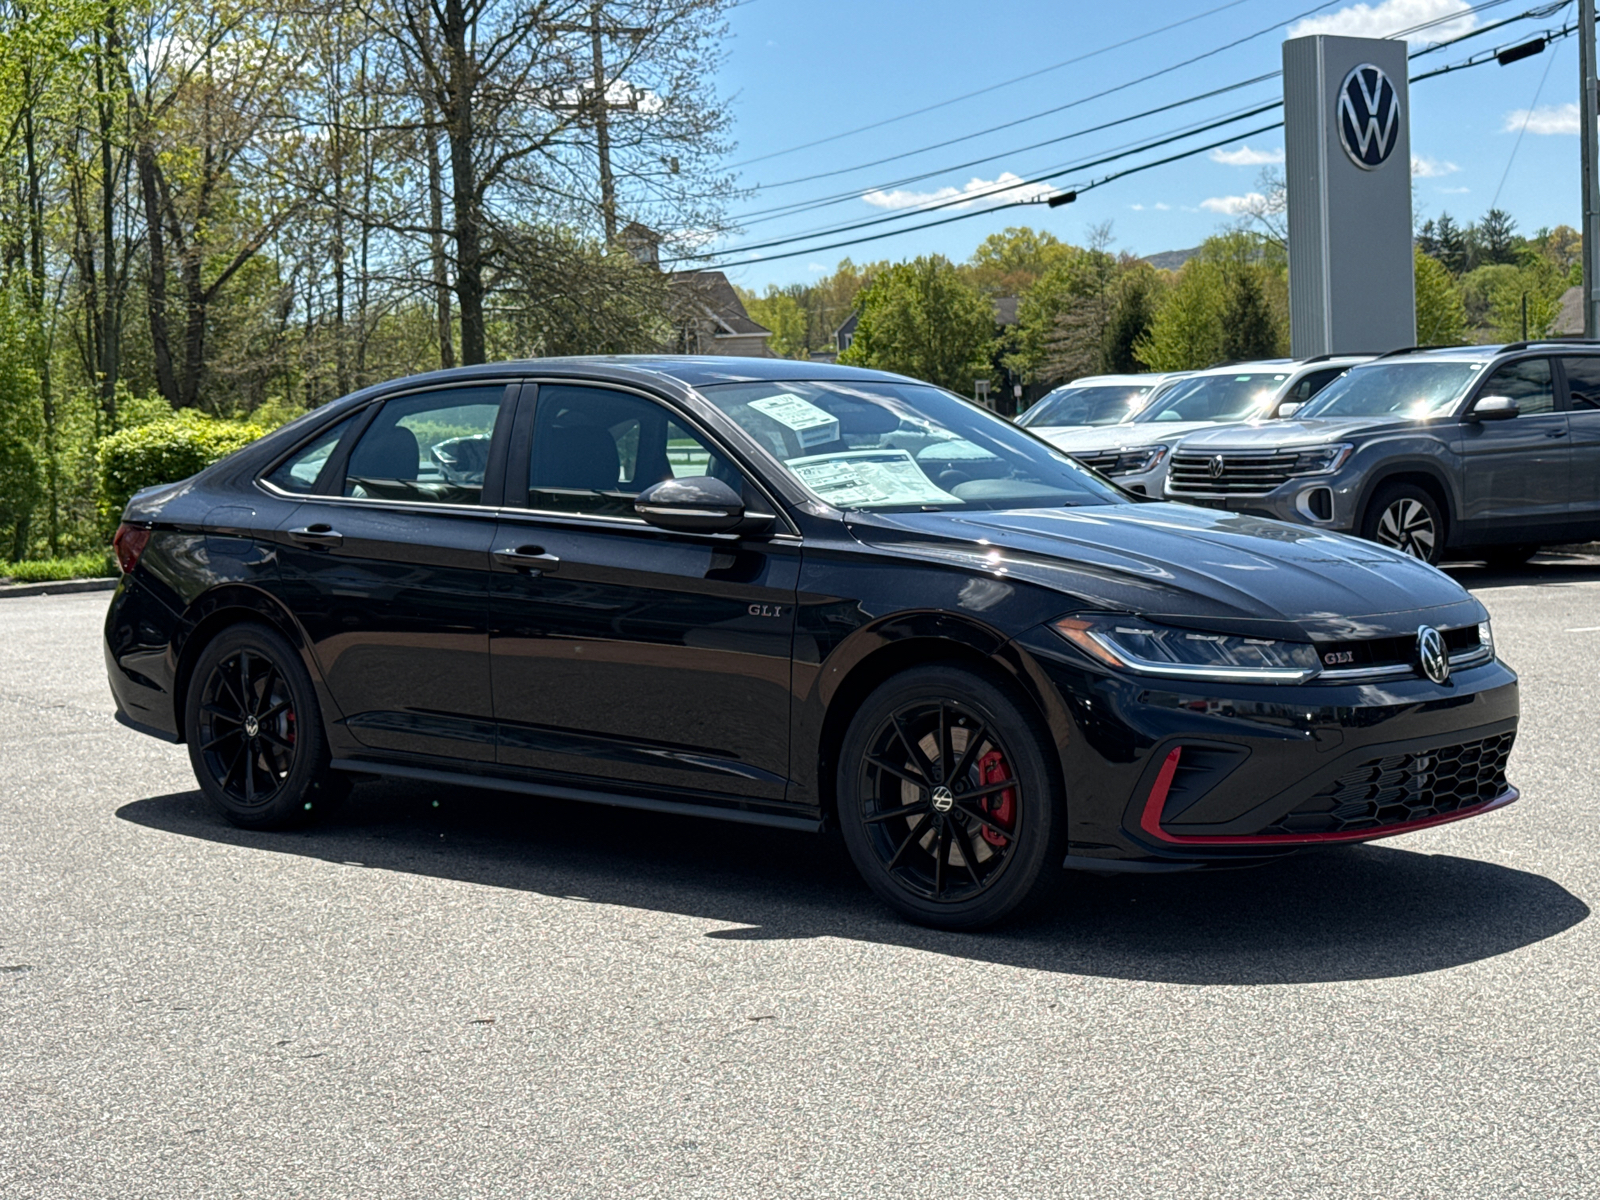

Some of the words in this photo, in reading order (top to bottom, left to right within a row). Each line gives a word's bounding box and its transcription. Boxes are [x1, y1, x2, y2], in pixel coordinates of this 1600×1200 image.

[1341, 66, 1398, 163] VW
[748, 604, 782, 617] GLI
[1324, 651, 1354, 665] GLI
[1422, 629, 1448, 681] VW
